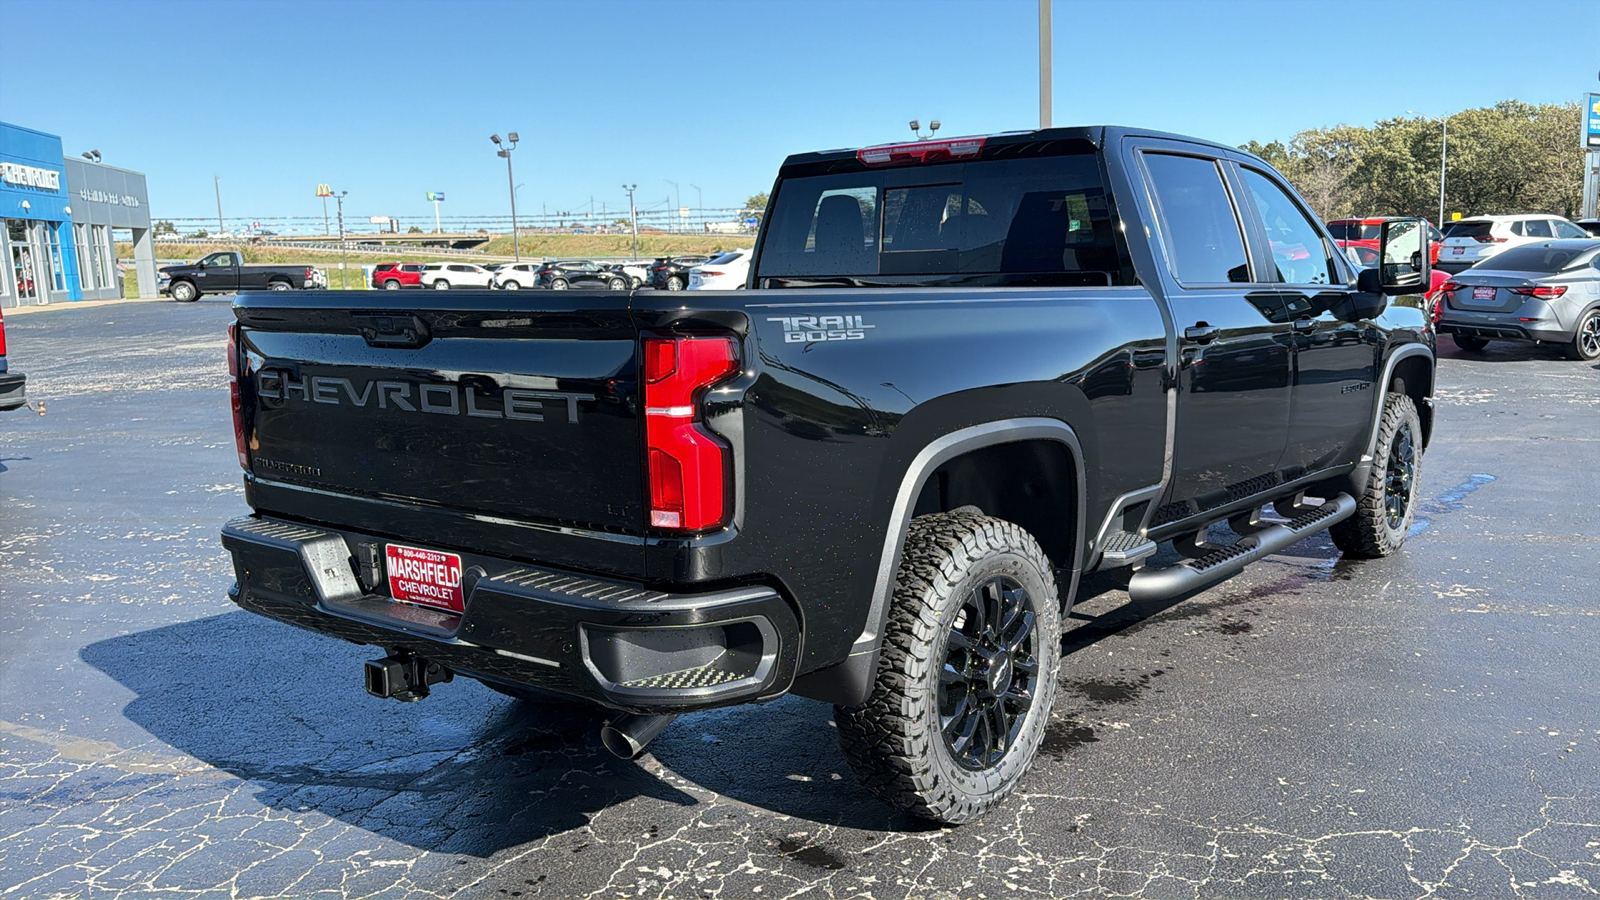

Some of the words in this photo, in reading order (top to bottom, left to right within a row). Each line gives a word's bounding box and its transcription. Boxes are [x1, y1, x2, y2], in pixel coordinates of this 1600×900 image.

[4, 163, 60, 190] CHEVROLET
[767, 315, 876, 331] TRAIL
[784, 329, 865, 343] BOSS
[258, 370, 596, 425] CHEVROLET
[254, 457, 322, 476] SILVERADO
[403, 549, 441, 562] 800-440-2312
[388, 556, 460, 588] MARSHFIELD
[398, 580, 454, 600] CHEVROLET
